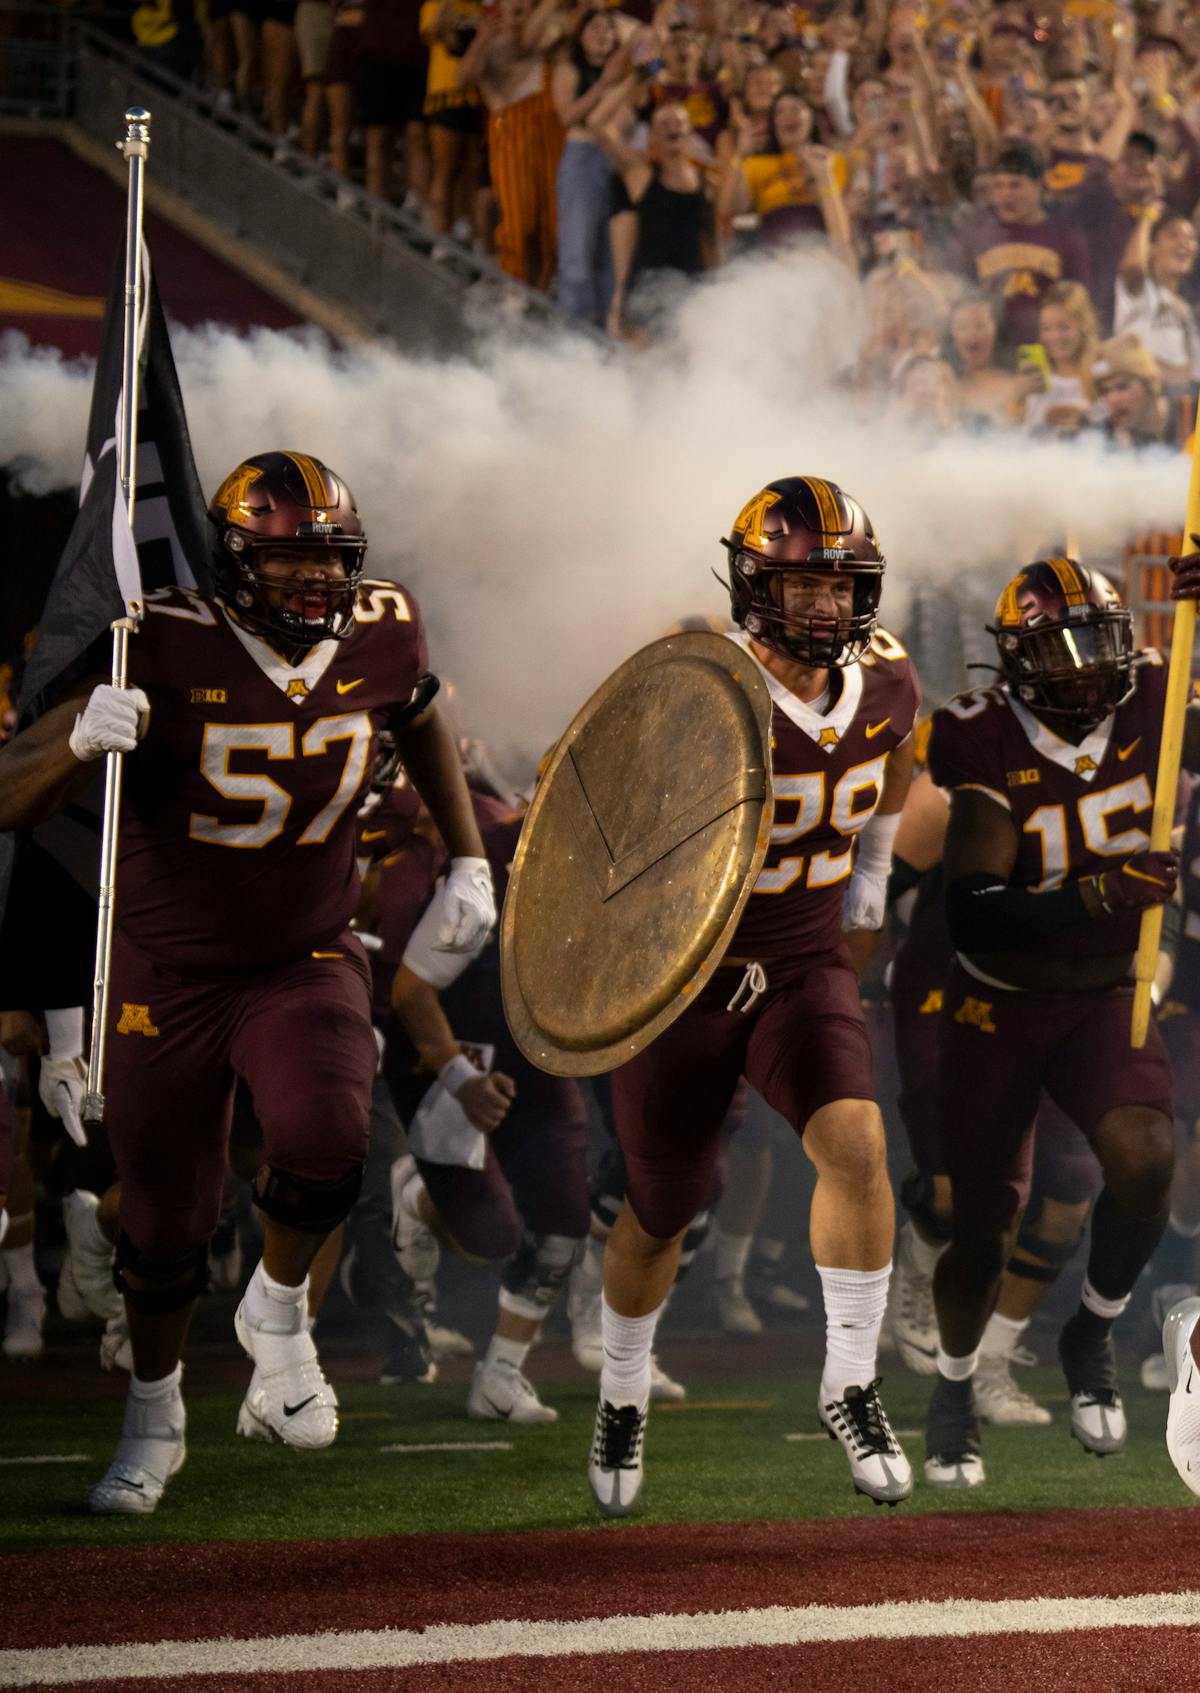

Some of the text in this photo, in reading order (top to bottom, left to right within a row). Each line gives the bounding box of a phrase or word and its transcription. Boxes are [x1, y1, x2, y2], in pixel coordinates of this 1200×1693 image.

[823, 549, 845, 560] ROW
[188, 708, 373, 849] 57
[752, 751, 889, 894] 29
[1023, 772, 1153, 893] 15
